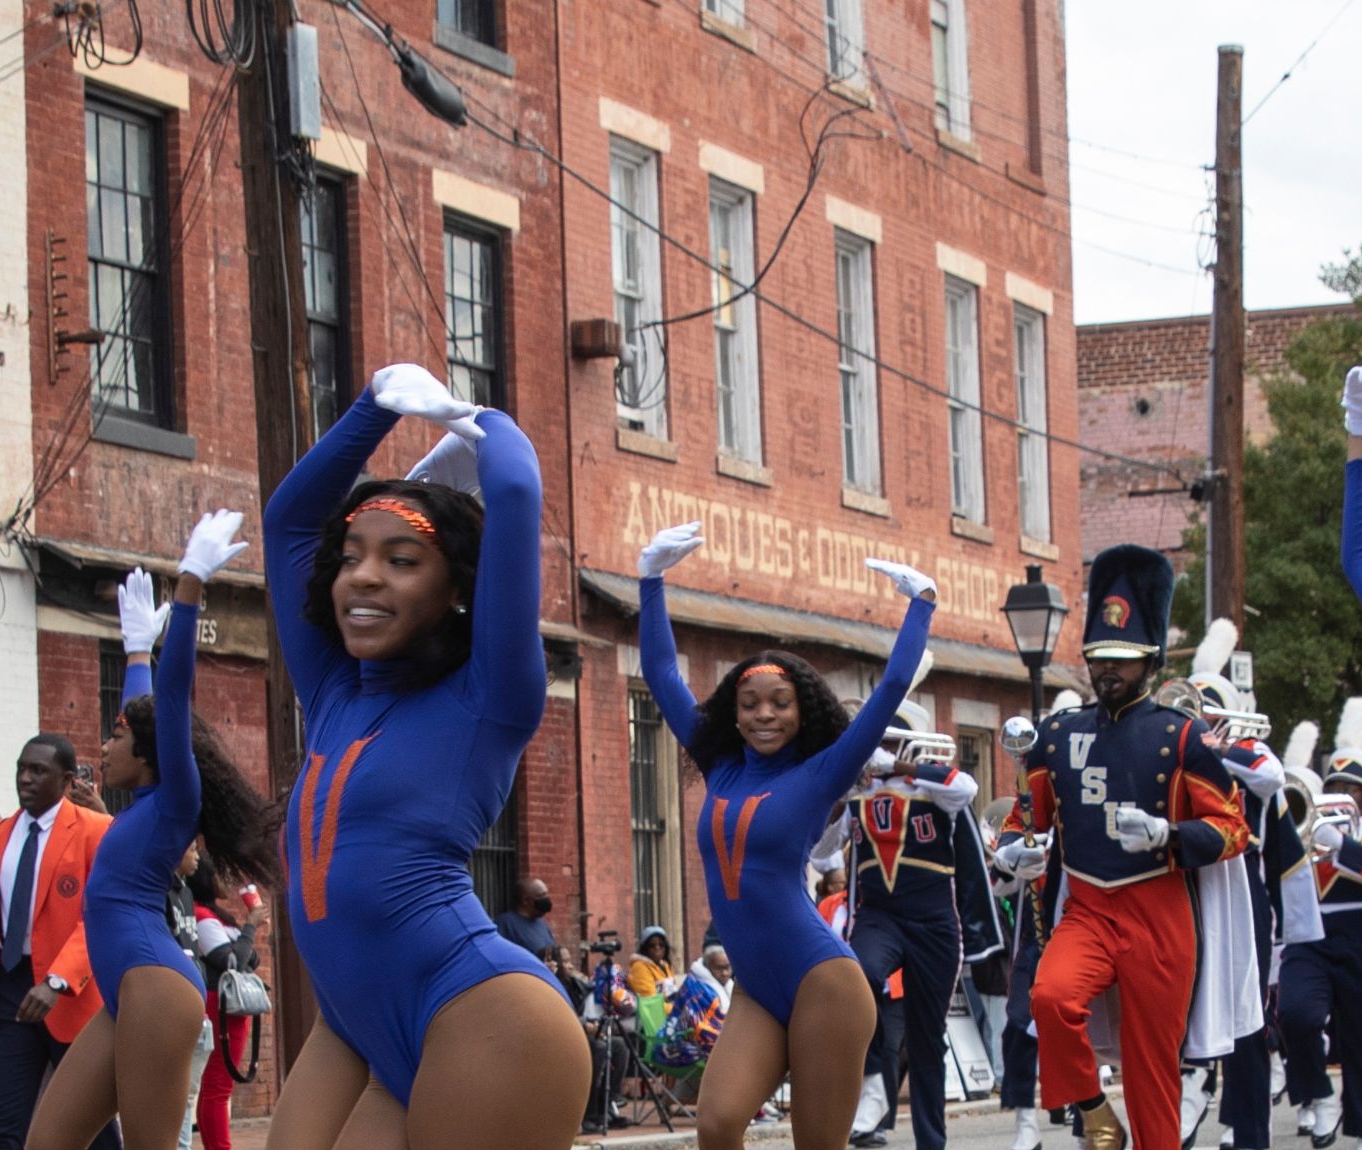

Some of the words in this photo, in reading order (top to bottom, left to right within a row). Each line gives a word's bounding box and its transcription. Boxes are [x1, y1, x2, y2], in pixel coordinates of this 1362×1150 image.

[624, 481, 793, 578] ANTIQUES
[798, 529, 811, 574] &
[1069, 733, 1095, 769] V
[1081, 767, 1107, 804] S
[299, 731, 383, 923] V
[711, 792, 769, 900] V
[873, 797, 893, 833] V
[912, 812, 937, 843] U
